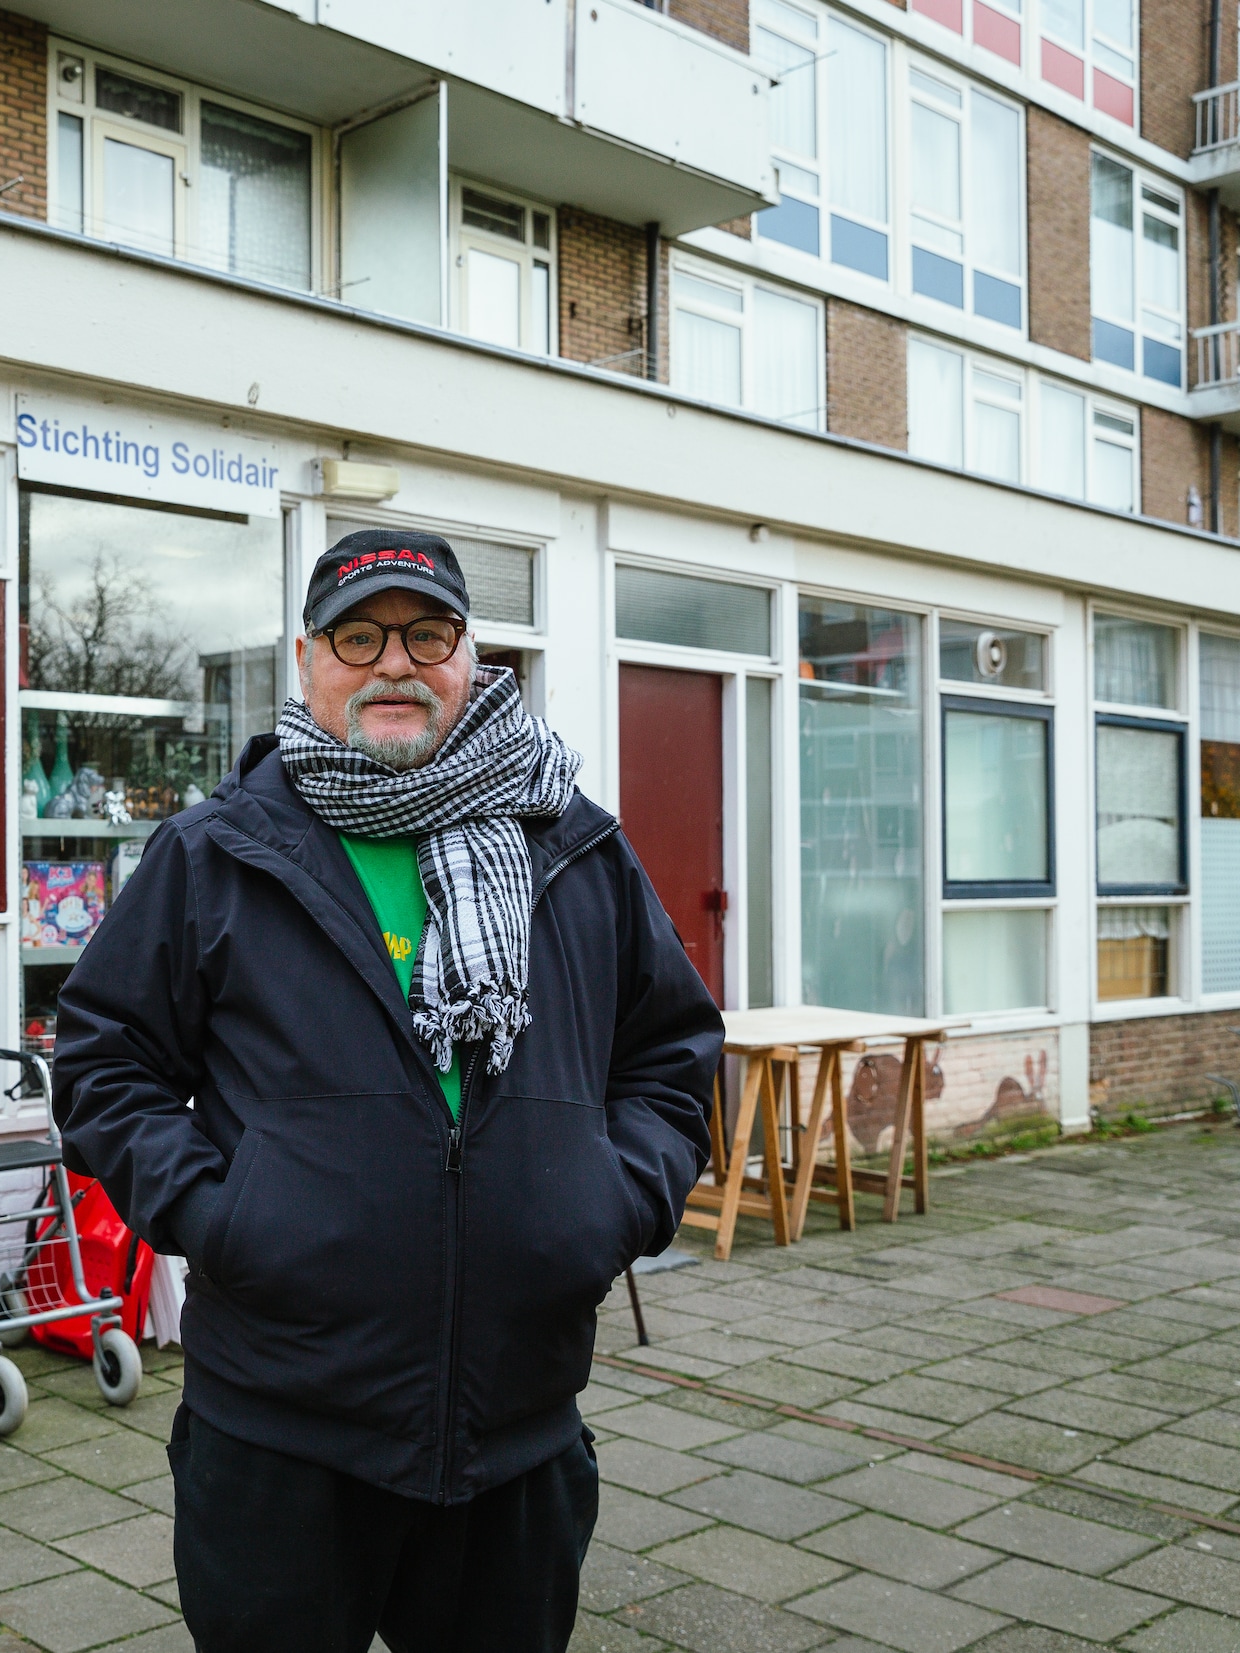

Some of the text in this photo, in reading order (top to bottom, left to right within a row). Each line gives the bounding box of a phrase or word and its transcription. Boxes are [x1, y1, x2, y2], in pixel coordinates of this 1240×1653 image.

[17, 413, 279, 489] Stichting Solidair
[337, 549, 435, 578] NISSAN
[337, 560, 435, 587] SPORTS ADVENTURE
